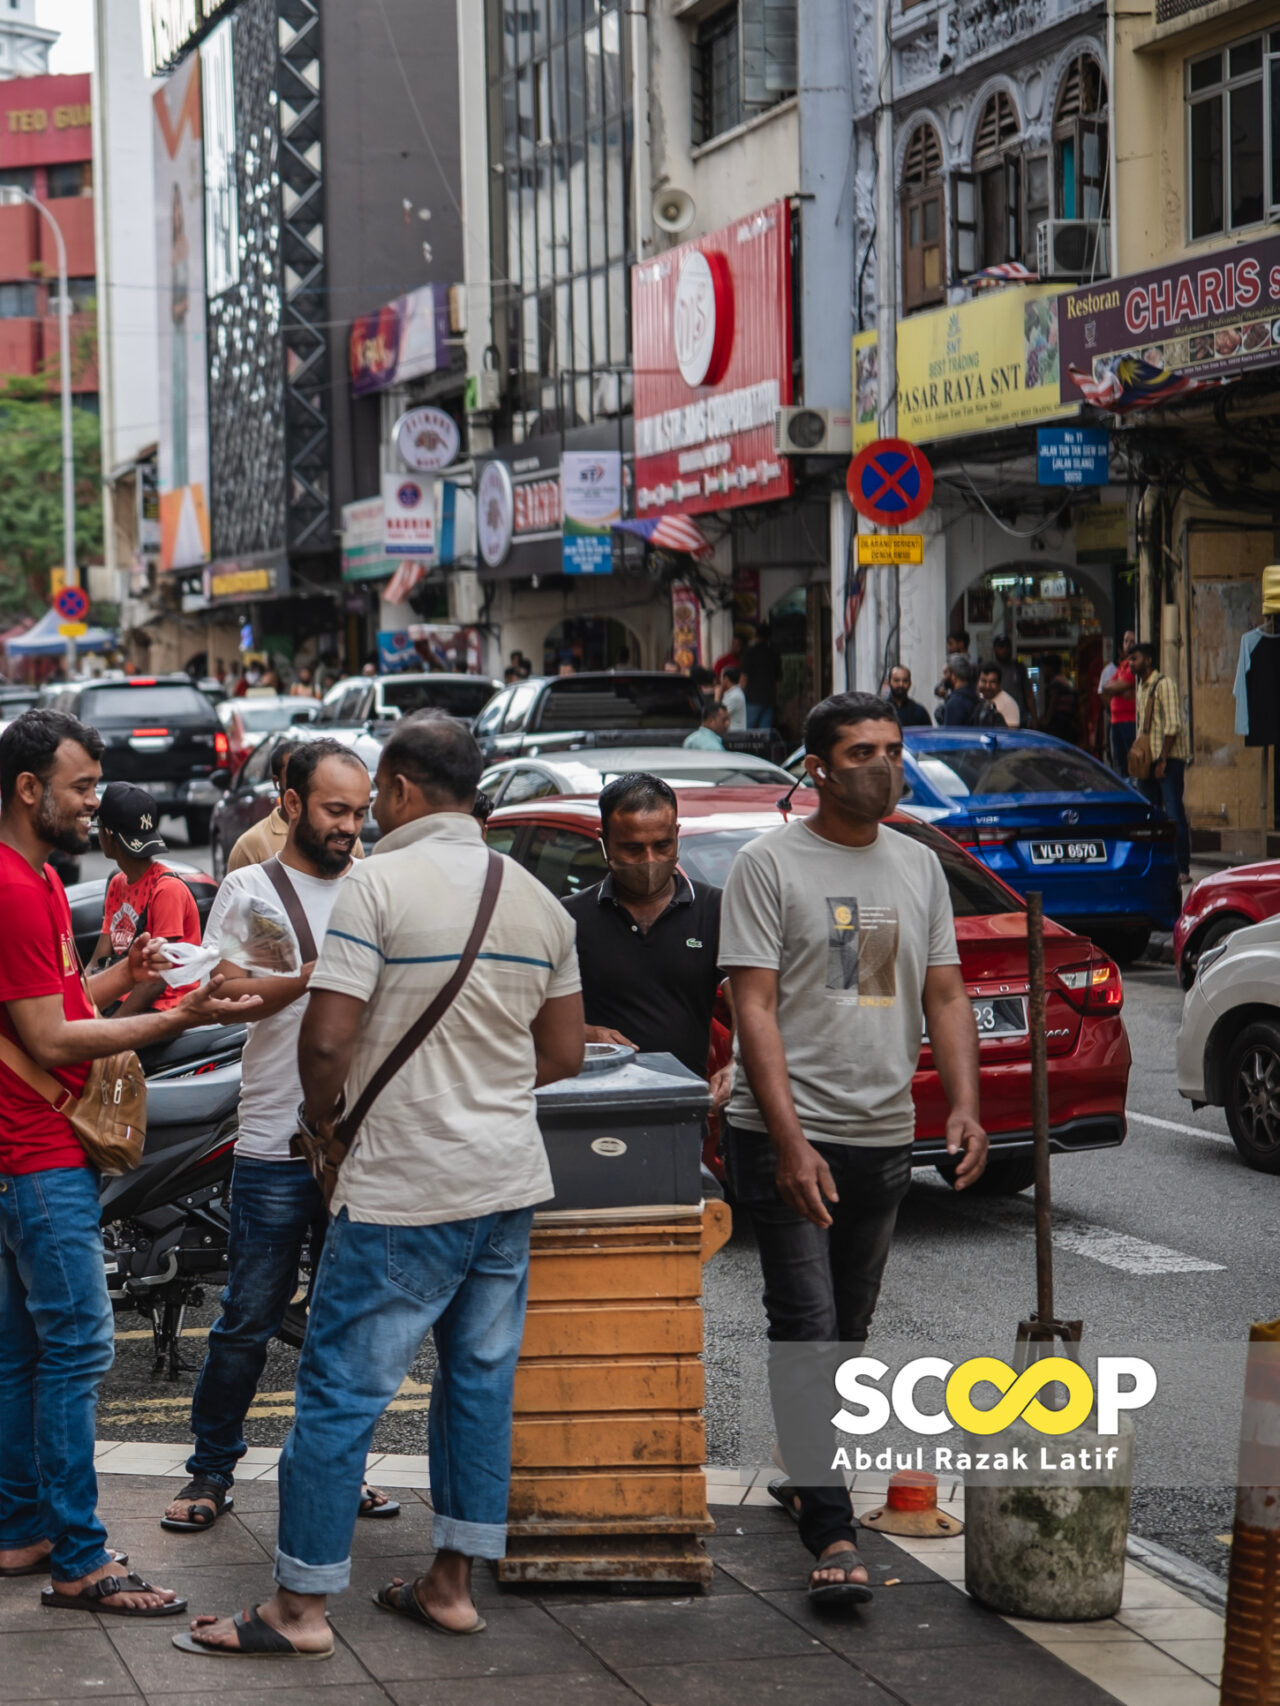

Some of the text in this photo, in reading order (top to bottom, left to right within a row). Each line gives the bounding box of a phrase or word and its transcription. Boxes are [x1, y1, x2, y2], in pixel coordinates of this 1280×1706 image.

[8, 109, 47, 132] TEO
[1066, 289, 1120, 320] Restoran
[1124, 258, 1262, 335] CHARIS
[948, 351, 980, 373] TRADING
[897, 364, 1021, 416] PASAR RAYA SNT
[1040, 445, 1057, 456] JALAN
[1040, 844, 1063, 859] VLD
